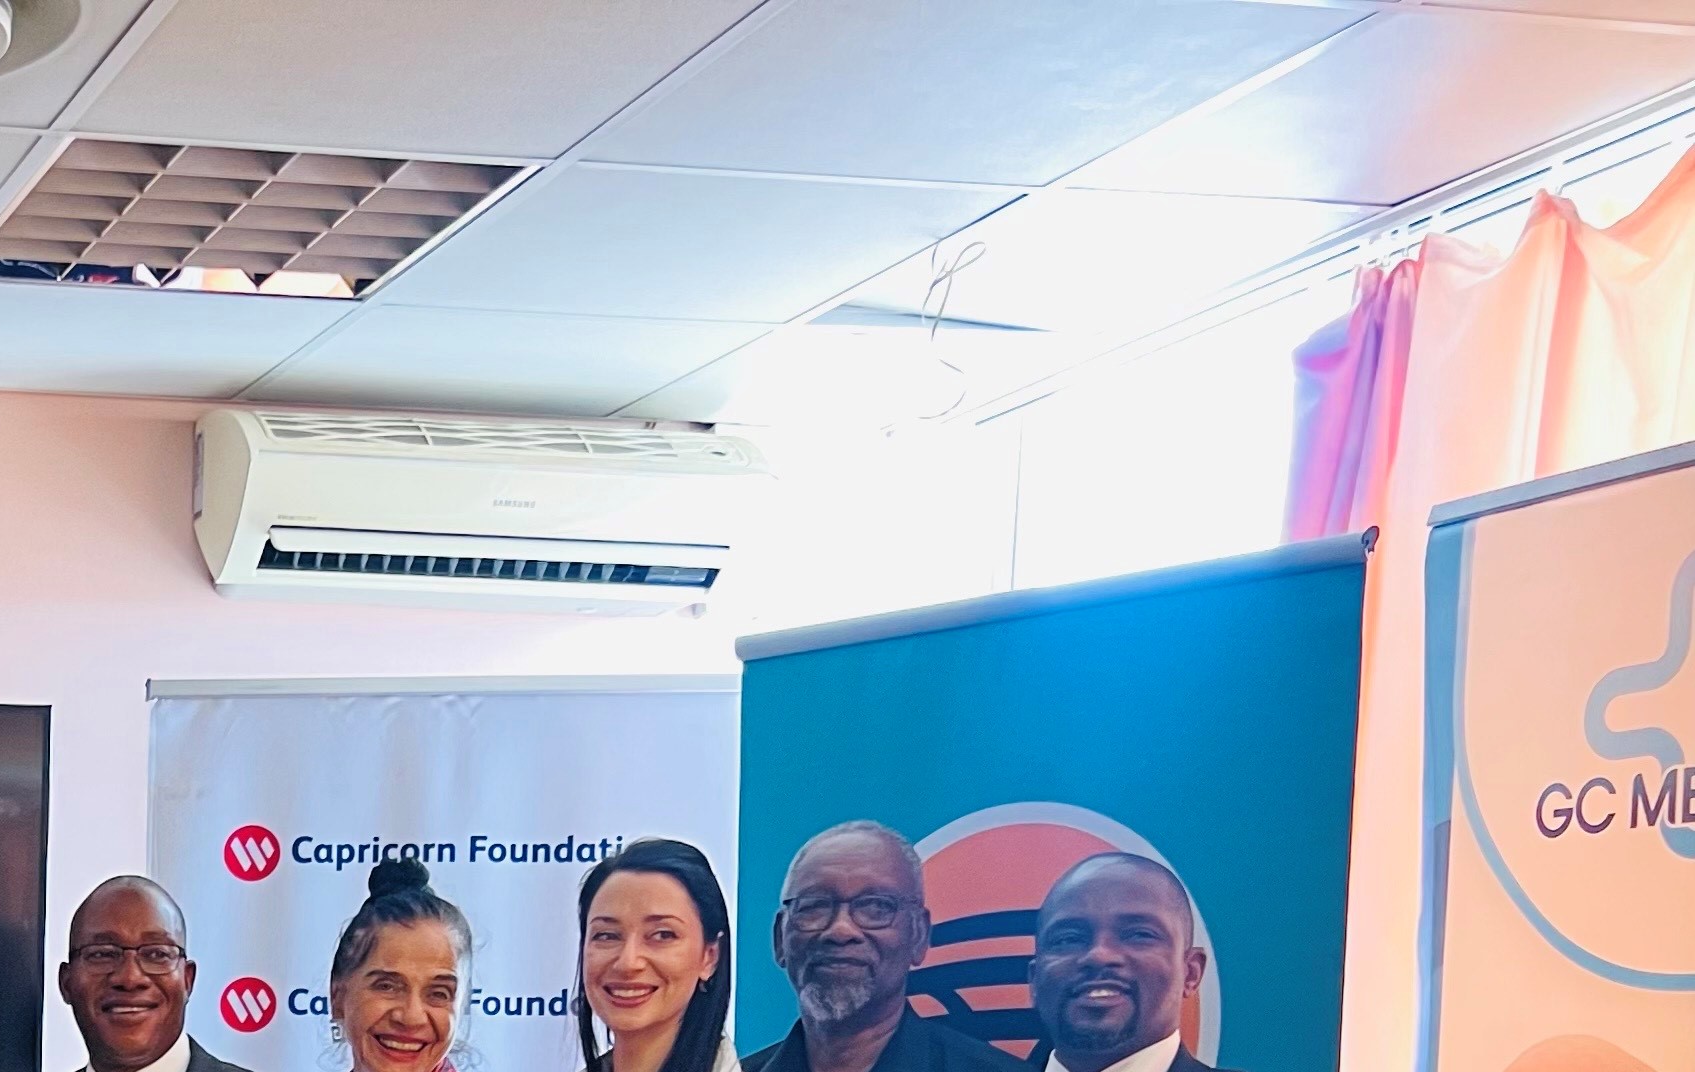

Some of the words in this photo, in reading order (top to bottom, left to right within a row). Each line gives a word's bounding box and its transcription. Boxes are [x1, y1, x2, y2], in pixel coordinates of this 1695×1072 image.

[1536, 776, 1617, 839] GC
[291, 835, 456, 871] Capricorn
[469, 834, 623, 863] Foundati
